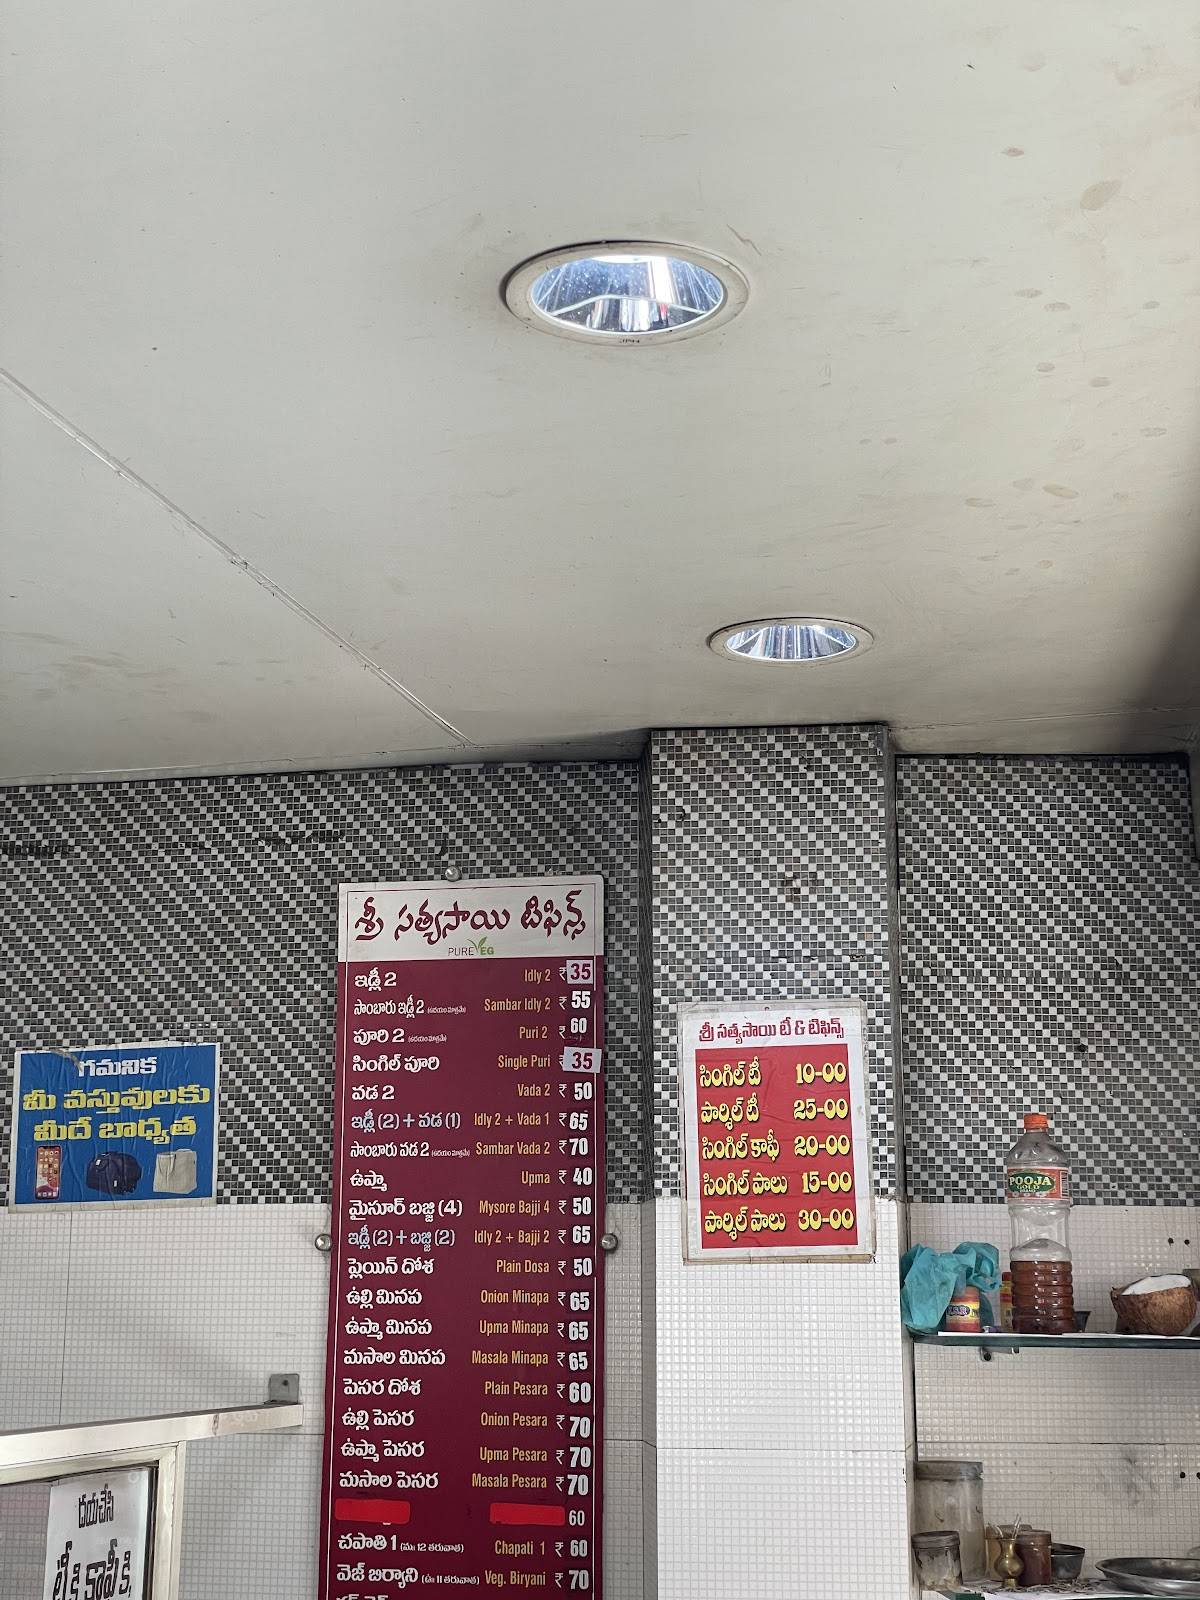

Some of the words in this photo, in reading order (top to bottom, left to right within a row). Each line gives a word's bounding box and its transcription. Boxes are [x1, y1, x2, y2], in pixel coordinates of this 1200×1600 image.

[355, 896, 385, 941] శ్రీ
[394, 899, 511, 945] సత్యసాయి
[521, 890, 586, 940] టిఫిన్స్
[448, 947, 474, 956] PURE
[355, 967, 381, 991] ఇడ్లీ
[384, 972, 396, 986] 2
[525, 969, 542, 984] Idly
[545, 969, 550, 981] 2
[570, 963, 591, 980] 35
[354, 999, 396, 1015] సాంబారు
[398, 995, 415, 1018] ఇడ్లీ
[416, 1000, 424, 1013] 2
[485, 998, 521, 1011] Sambar
[525, 998, 541, 1013] Idly
[545, 997, 550, 1009] 2
[572, 991, 590, 1008] 55
[354, 1029, 389, 1045] పూరి
[392, 1028, 404, 1042] 2
[520, 1026, 538, 1038] Puri
[542, 1026, 547, 1038] 2
[571, 1018, 587, 1033] 60
[699, 1022, 714, 1041] శ్రీ
[717, 1022, 776, 1044] సత్యసాయి
[353, 1054, 401, 1071] సింగిల్
[404, 1056, 439, 1072] పూరి
[498, 1055, 527, 1070] Single
[531, 1055, 550, 1067] Puri
[571, 1052, 592, 1070] 35
[700, 1061, 745, 1087] సింగిల్
[796, 1062, 846, 1084] 10-00
[352, 1085, 378, 1100] వడ
[382, 1085, 394, 1099] 2
[518, 1084, 541, 1096] Vada
[544, 1084, 550, 1096] 2
[574, 1082, 592, 1100] 50
[794, 1099, 848, 1120] 25-00
[352, 1109, 375, 1133] ఇడ్లీ
[378, 1114, 399, 1130] (2)
[419, 1112, 442, 1127] వడ
[445, 1113, 460, 1129] (1)
[475, 1113, 492, 1128] Idly
[495, 1113, 500, 1125] 2
[517, 1113, 541, 1125] Vada
[545, 1112, 548, 1125] 1
[570, 1111, 588, 1130] 65
[350, 1141, 397, 1157] సాంబారు
[400, 1142, 418, 1156] వడ
[420, 1142, 429, 1156] 2
[476, 1142, 514, 1155] Sambar
[517, 1142, 540, 1154] Vada
[544, 1142, 550, 1154] 2
[569, 1138, 588, 1155] 70
[702, 1133, 748, 1159] సింగిల్
[794, 1135, 850, 1157] 20-00
[522, 1171, 550, 1186] Upma
[573, 1167, 592, 1185] 40
[703, 1170, 750, 1195] సింగిల్
[802, 1171, 852, 1193] 15-00
[1010, 1176, 1051, 1185] POOJA
[349, 1198, 405, 1220] మైసూర్
[409, 1202, 435, 1222] బజ్జి
[438, 1200, 462, 1217] (4)
[480, 1200, 515, 1216] Mysore
[519, 1200, 540, 1216] Bajji
[544, 1200, 549, 1213] 4
[573, 1197, 591, 1215] 50
[798, 1208, 853, 1230] 30-00
[348, 1225, 370, 1249] ఇడ్లీ
[373, 1230, 393, 1246] (2)
[410, 1232, 431, 1252] బజ్జి
[435, 1229, 455, 1246] (2)
[475, 1230, 492, 1246] Idly
[495, 1230, 501, 1243] 2
[519, 1230, 540, 1246] Bajji
[544, 1230, 549, 1243] 2
[573, 1226, 590, 1243] 65
[497, 1260, 521, 1272] Plain
[525, 1260, 549, 1273] Dosa
[574, 1258, 592, 1276] 50
[376, 1289, 422, 1304] మినప
[481, 1290, 508, 1303] Onion
[513, 1290, 548, 1306] Minapa
[570, 1292, 589, 1310] 65
[386, 1319, 432, 1334] మినప
[480, 1320, 508, 1336] Upma
[512, 1320, 548, 1336] Minapa
[569, 1322, 588, 1340] 65
[344, 1347, 396, 1364] మసాల
[399, 1349, 445, 1364] మినప
[472, 1351, 508, 1363] Masala
[512, 1351, 548, 1367] Minapa
[569, 1352, 588, 1370] 65
[343, 1378, 384, 1395] పెసర
[485, 1381, 509, 1394] Plain
[514, 1382, 547, 1395] Pesara
[569, 1382, 591, 1403] 60
[372, 1409, 414, 1426] పెసర
[481, 1412, 509, 1425] Onion
[513, 1413, 547, 1426] Pesara
[570, 1416, 590, 1438] 70
[383, 1440, 424, 1457] పెసర
[480, 1447, 508, 1463] Upma
[513, 1447, 547, 1461] Pesara
[570, 1447, 591, 1467] 70
[340, 1470, 392, 1487] మసాల
[396, 1471, 438, 1488] పెసర
[472, 1473, 508, 1487] Masala
[512, 1474, 546, 1488] Pesara
[567, 1474, 588, 1495] 70
[569, 1510, 585, 1526] 60
[338, 1533, 387, 1550] చపాతి
[391, 1535, 396, 1550] 1
[495, 1540, 533, 1557] Chapati
[540, 1541, 544, 1555] 1
[571, 1540, 587, 1557] 60
[485, 1570, 506, 1587] Veg.
[510, 1571, 545, 1587] Biryani
[569, 1570, 589, 1589] 70
